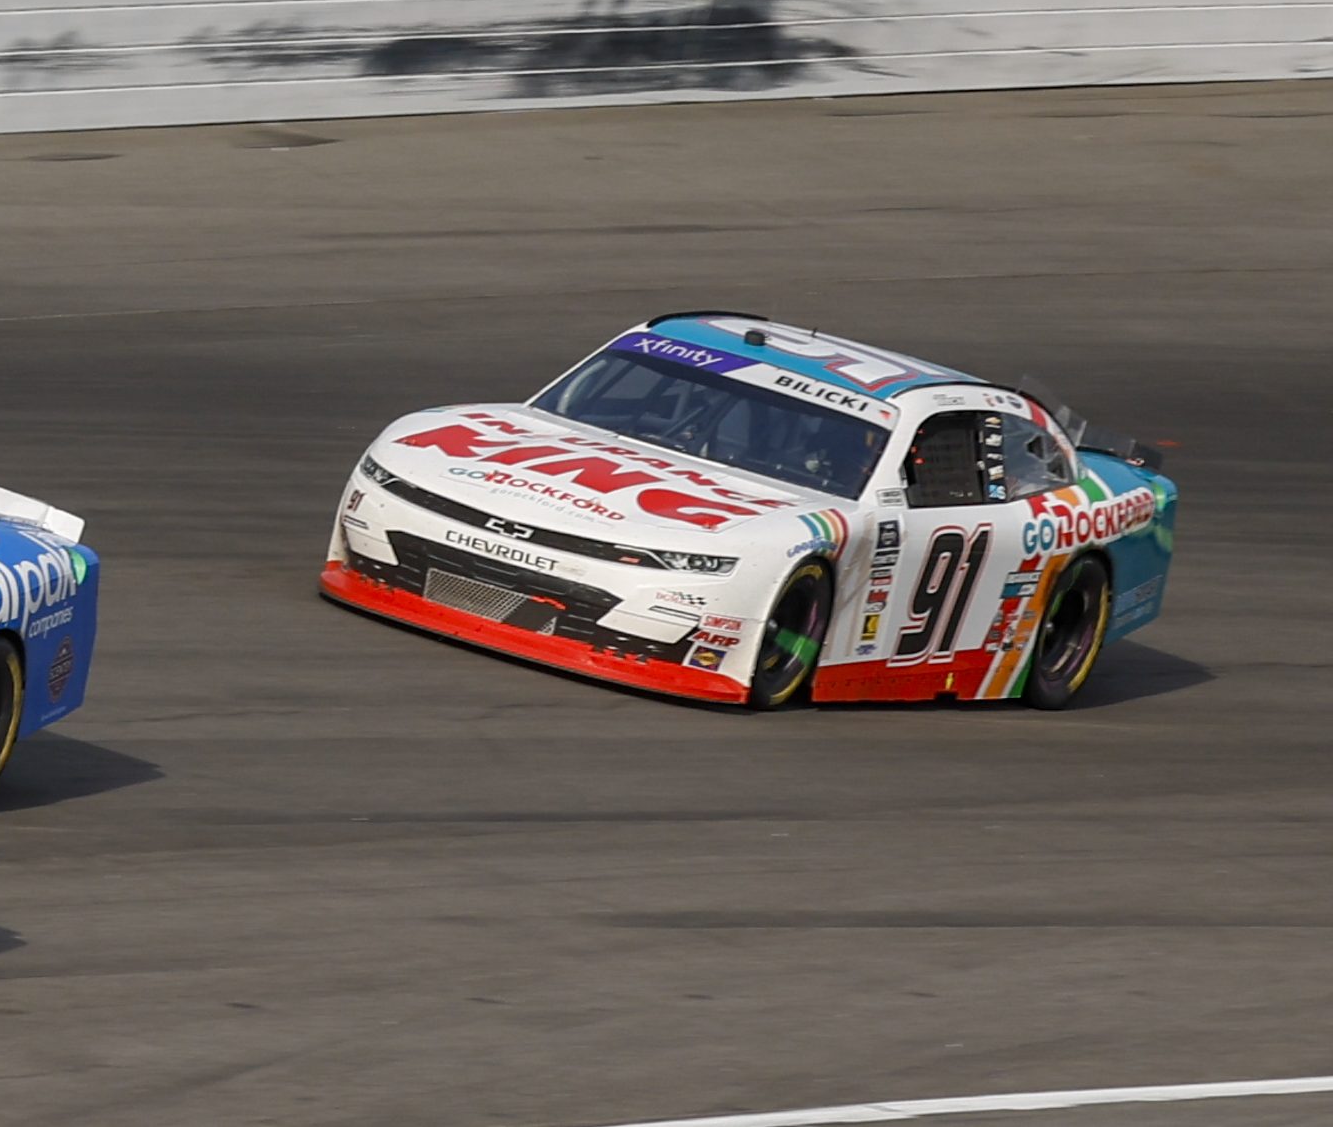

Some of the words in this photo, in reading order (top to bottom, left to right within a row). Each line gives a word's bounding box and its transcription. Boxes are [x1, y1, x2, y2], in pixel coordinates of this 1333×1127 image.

[634, 337, 724, 366] xfinity
[773, 375, 870, 414] BILICKI
[393, 423, 763, 530] KING
[347, 489, 367, 512] 91
[445, 529, 560, 572] CHEVROLET
[888, 524, 992, 666] 91
[692, 630, 741, 647] ARP
